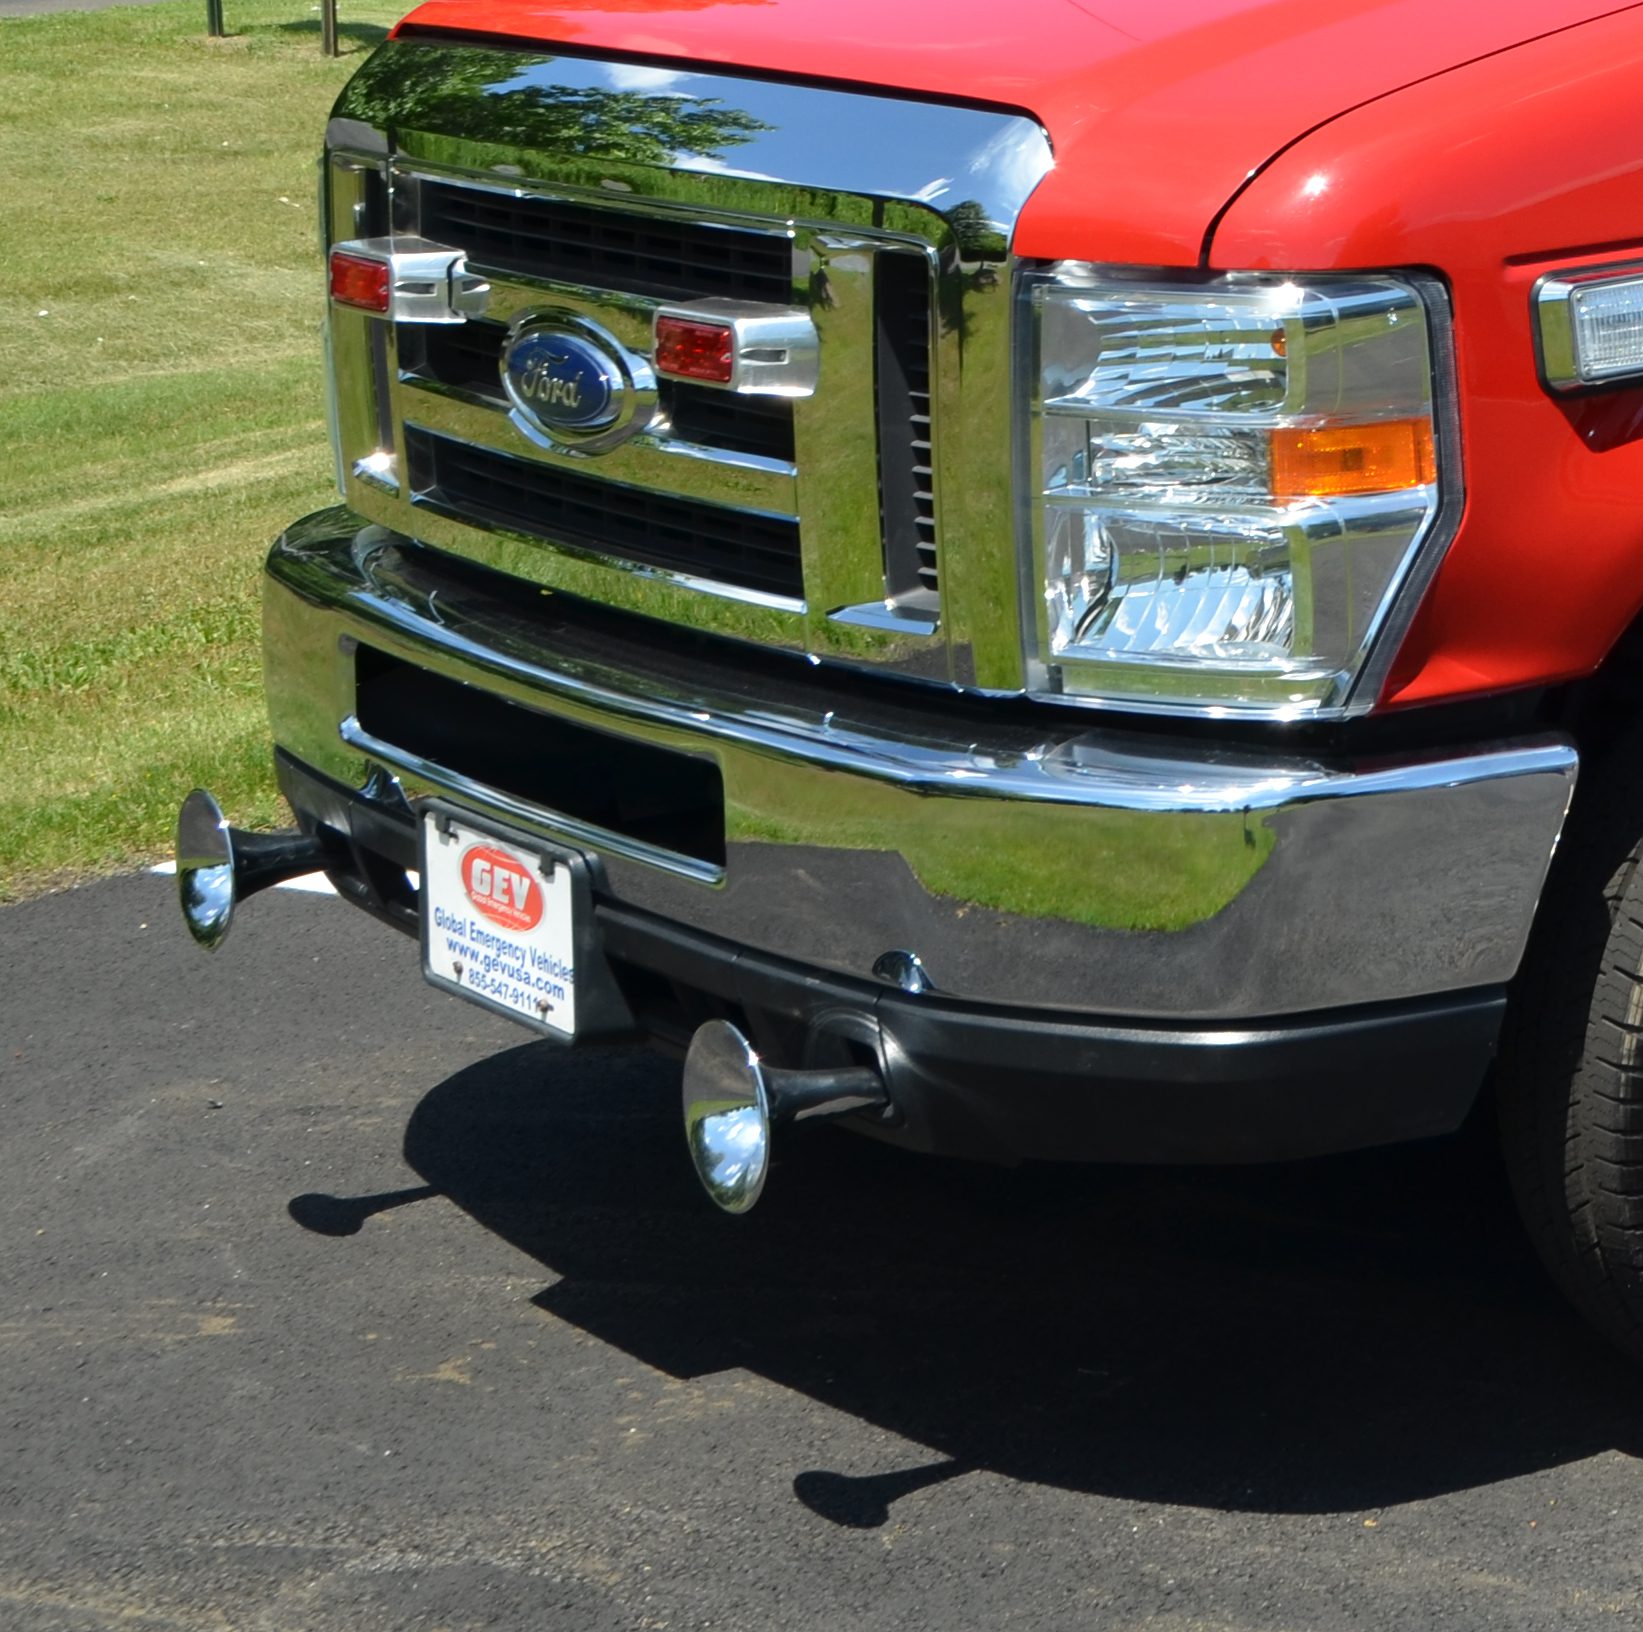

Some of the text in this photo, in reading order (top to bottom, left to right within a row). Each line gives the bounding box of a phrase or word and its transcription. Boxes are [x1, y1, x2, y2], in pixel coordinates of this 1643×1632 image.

[520, 347, 584, 408] Ford
[471, 857, 531, 910] GEV
[434, 906, 574, 984] Global Emergency Vehicles
[446, 937, 565, 1000] www.gevusa.com
